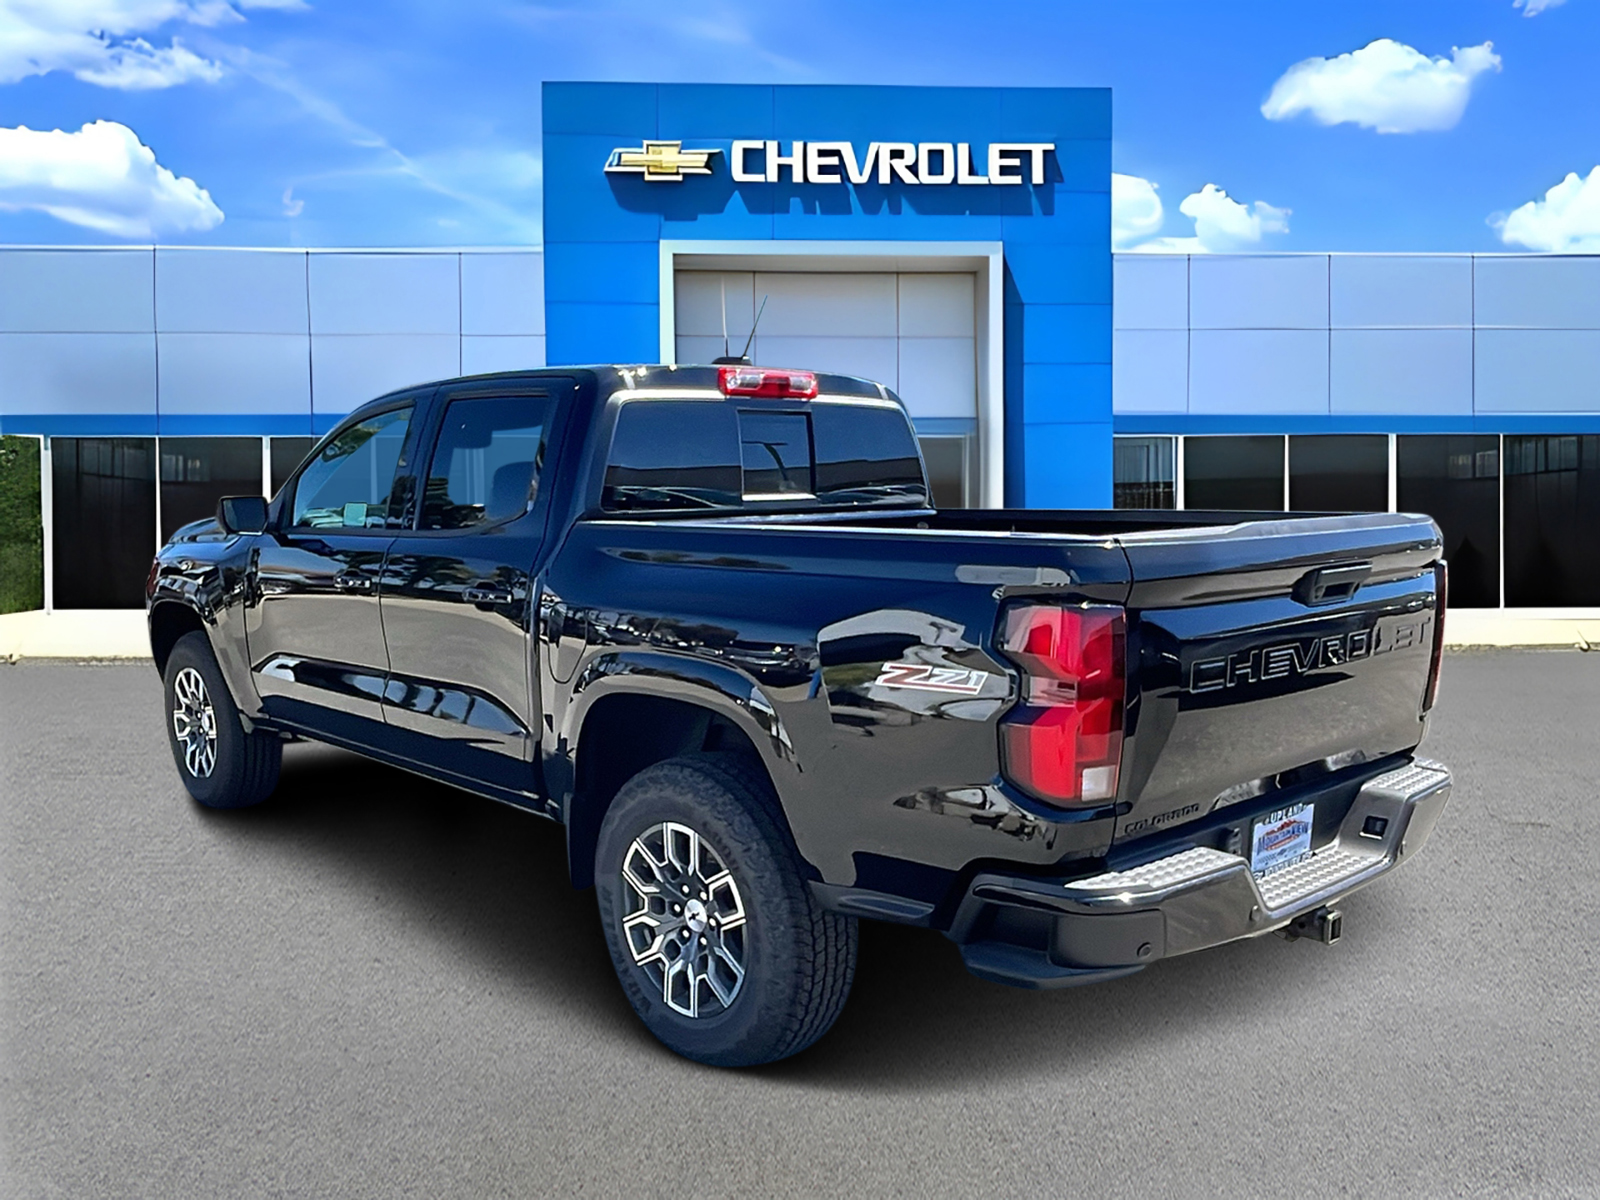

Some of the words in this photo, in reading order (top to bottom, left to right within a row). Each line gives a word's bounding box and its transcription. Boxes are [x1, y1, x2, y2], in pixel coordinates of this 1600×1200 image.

[731, 140, 1055, 185] CHEVROLET
[1189, 616, 1432, 694] CHEVROLET
[875, 662, 989, 695] Z71
[1124, 802, 1200, 837] COLORADO
